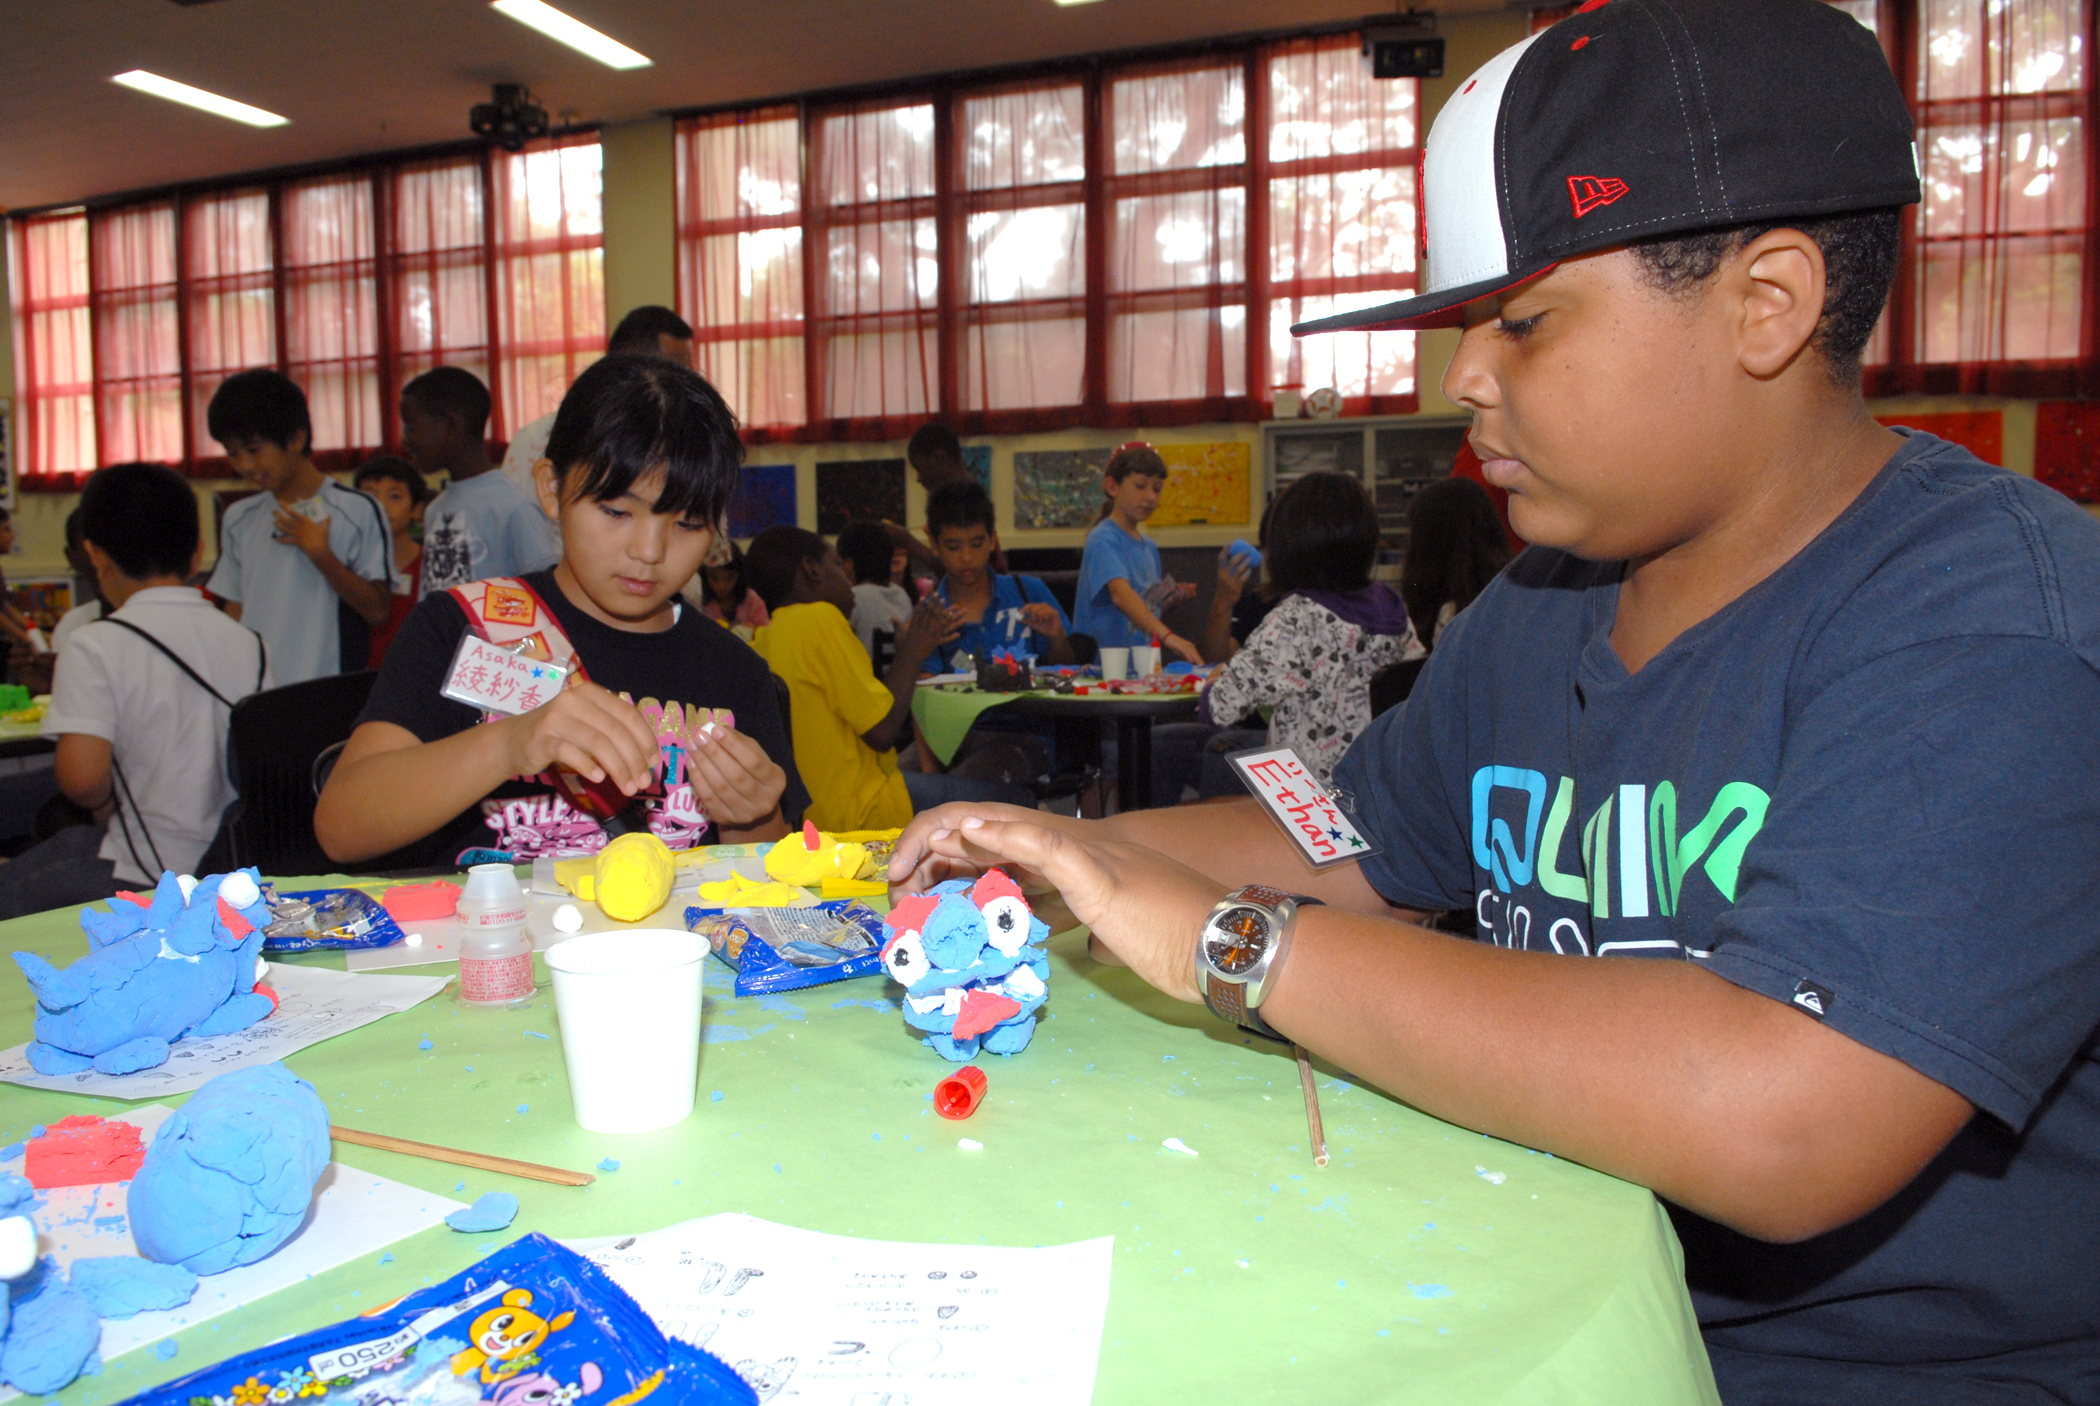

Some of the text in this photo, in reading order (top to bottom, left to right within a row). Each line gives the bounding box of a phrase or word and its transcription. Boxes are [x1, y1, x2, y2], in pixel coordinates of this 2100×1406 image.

[471, 644, 528, 673] Asaka
[451, 660, 542, 711] 綾紗香
[1247, 759, 1337, 857] Ethan
[1287, 762, 1338, 825] いーさん
[338, 1341, 396, 1368] 250
